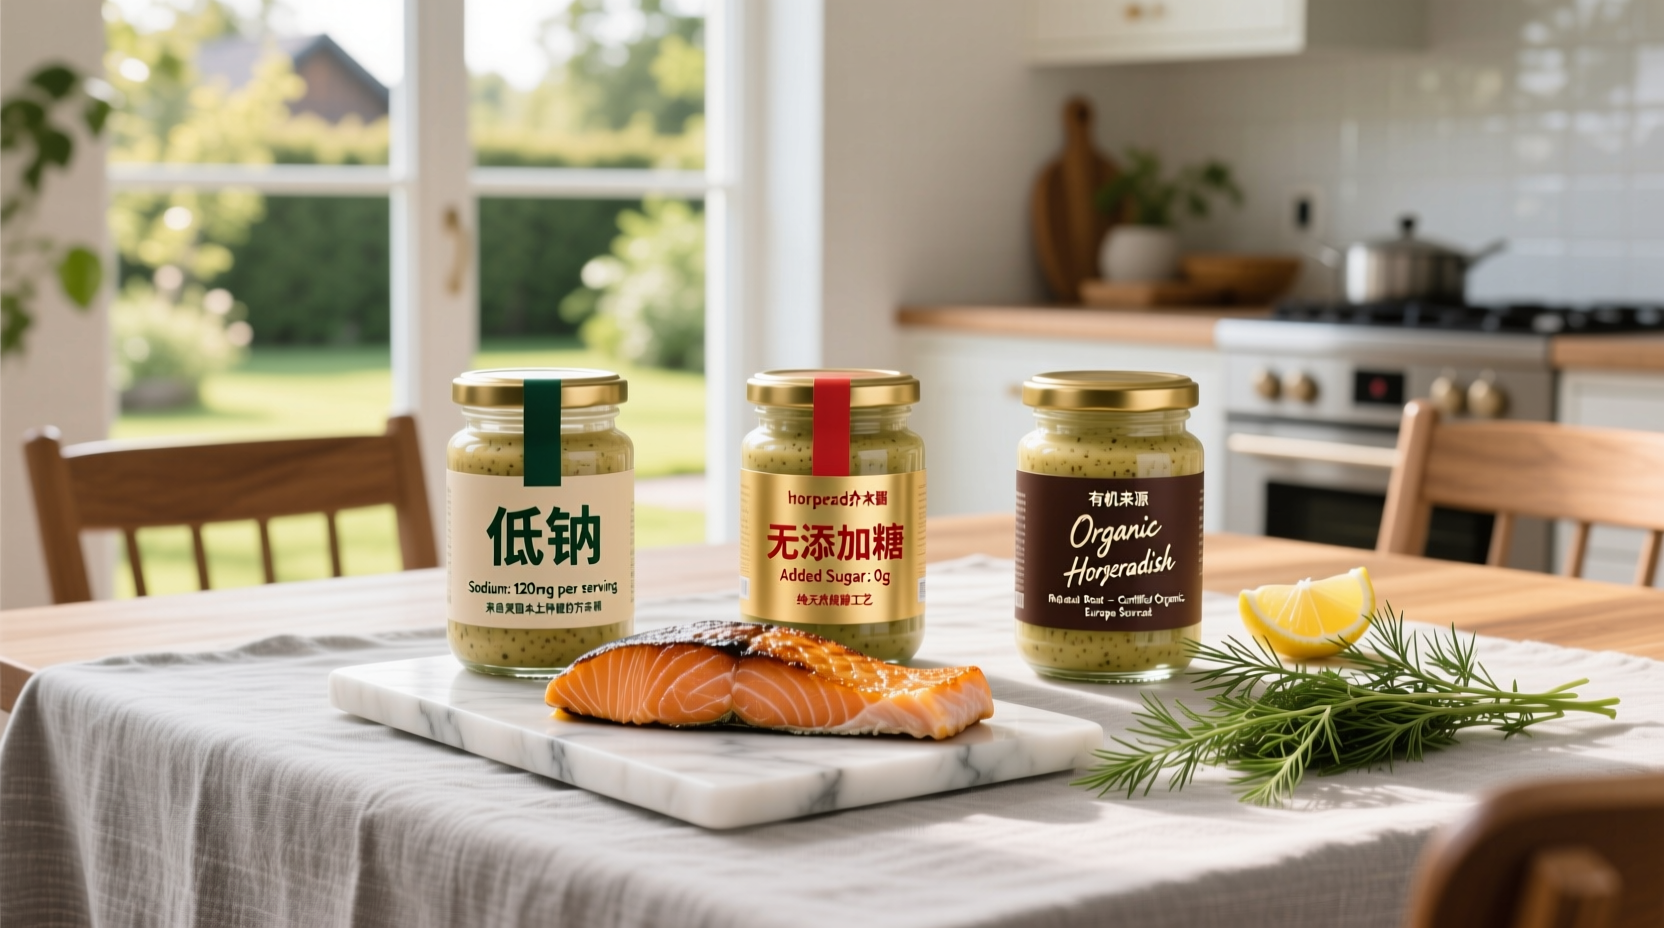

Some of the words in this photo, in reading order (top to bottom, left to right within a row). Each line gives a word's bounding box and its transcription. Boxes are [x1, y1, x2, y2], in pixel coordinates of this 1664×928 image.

[1088, 490, 1149, 507] 有机来源
[486, 504, 601, 566] 低钠
[767, 522, 905, 561] 无添加糖
[1070, 514, 1162, 558] Organic
[779, 568, 822, 582] Added
[826, 569, 871, 586] Sugar:
[874, 568, 890, 586] 0g
[557, 584, 578, 599] per
